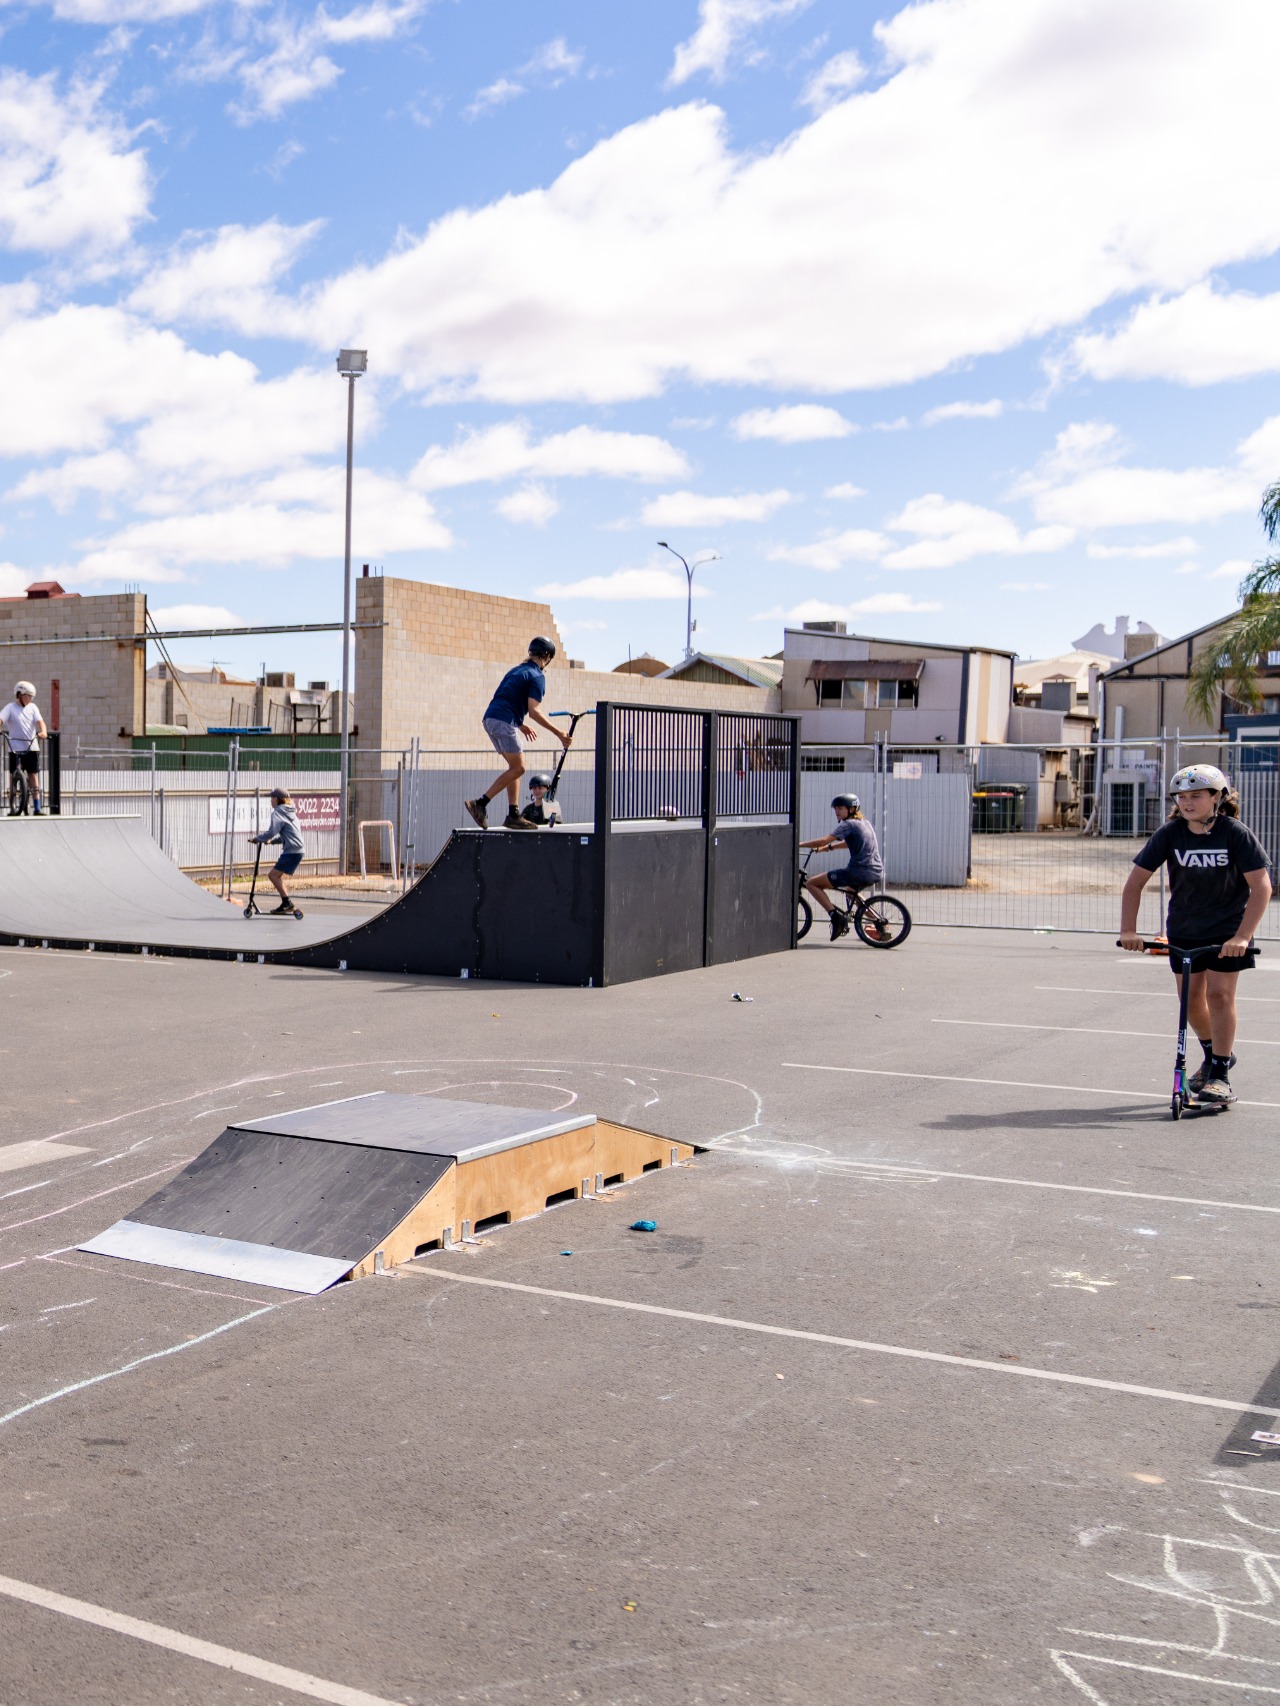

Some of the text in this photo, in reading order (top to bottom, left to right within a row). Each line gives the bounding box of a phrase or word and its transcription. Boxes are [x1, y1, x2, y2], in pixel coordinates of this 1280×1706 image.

[298, 797, 339, 813] 9022 2234
[1174, 848, 1229, 868] VANS
